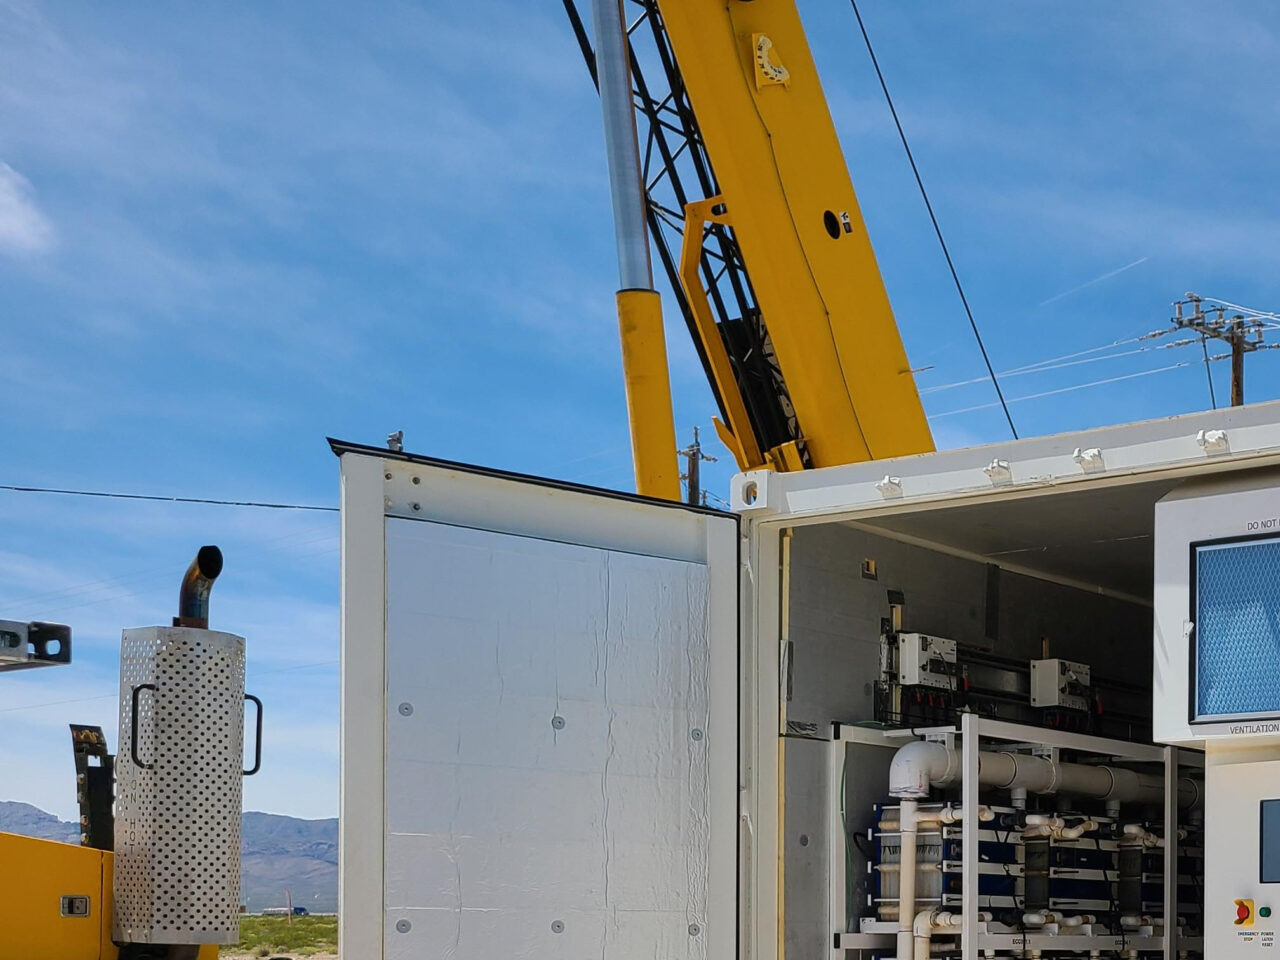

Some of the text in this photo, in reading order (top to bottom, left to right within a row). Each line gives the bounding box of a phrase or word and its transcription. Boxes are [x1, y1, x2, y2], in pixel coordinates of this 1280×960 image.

[1247, 520, 1259, 531] DO
[1261, 518, 1277, 529] NOT
[1230, 723, 1280, 735] VENTILATION
